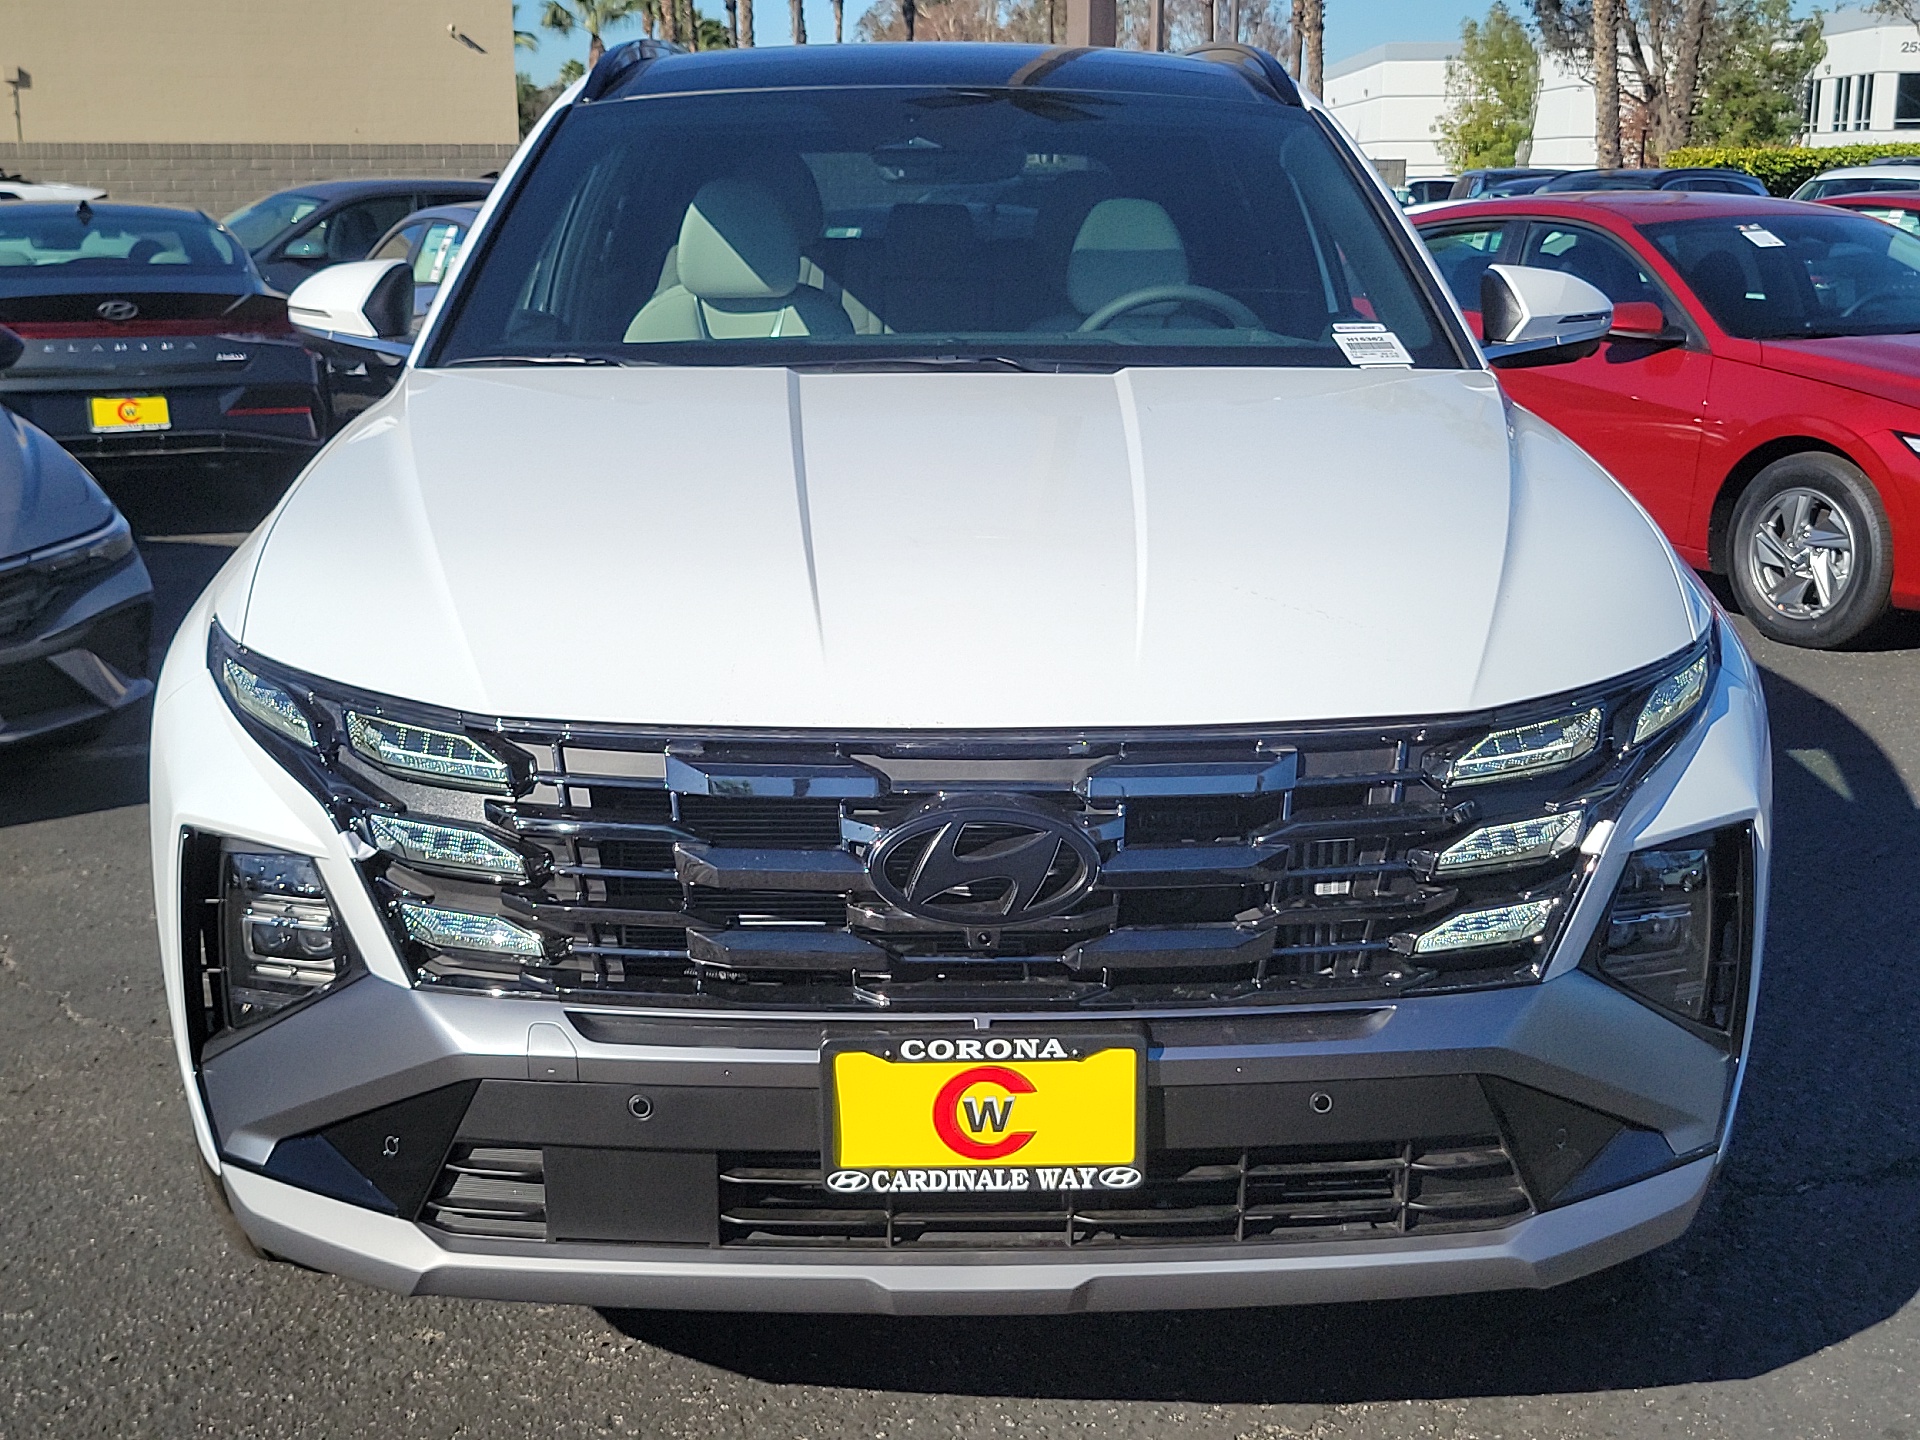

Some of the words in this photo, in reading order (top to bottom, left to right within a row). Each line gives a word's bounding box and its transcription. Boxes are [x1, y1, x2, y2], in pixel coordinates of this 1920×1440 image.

[1901, 41, 1920, 53] 25
[900, 1038, 1068, 1060] CORONA
[872, 1169, 1030, 1192] CARDINALE
[1035, 1167, 1098, 1189] WAY
